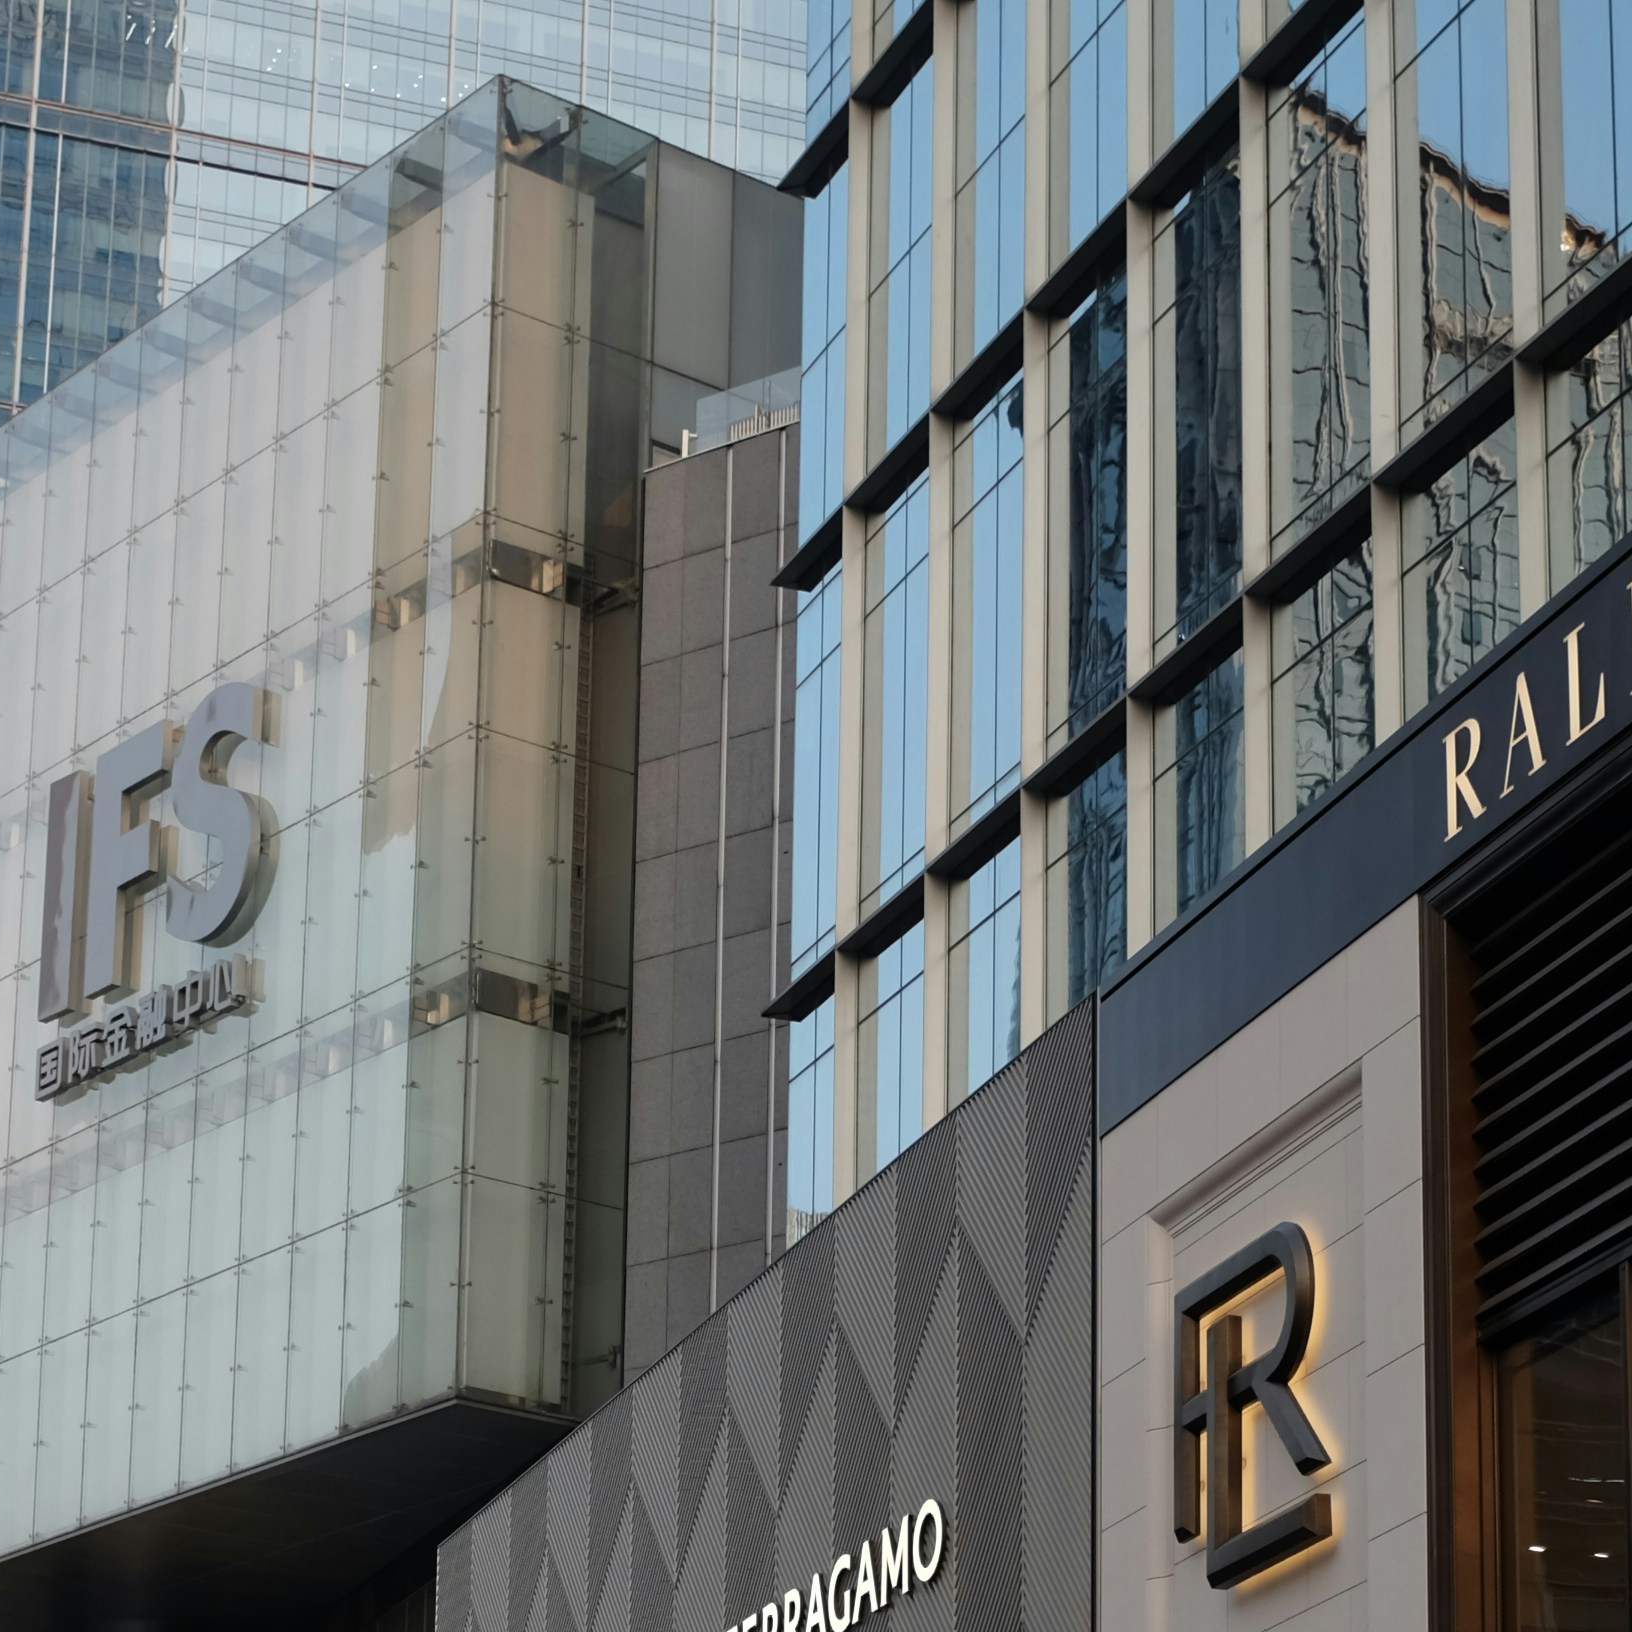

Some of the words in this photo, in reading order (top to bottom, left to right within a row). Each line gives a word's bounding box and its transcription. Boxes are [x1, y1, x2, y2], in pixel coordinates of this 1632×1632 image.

[37, 681, 268, 1024] IFS
[35, 955, 250, 1102] 国际金融中心
